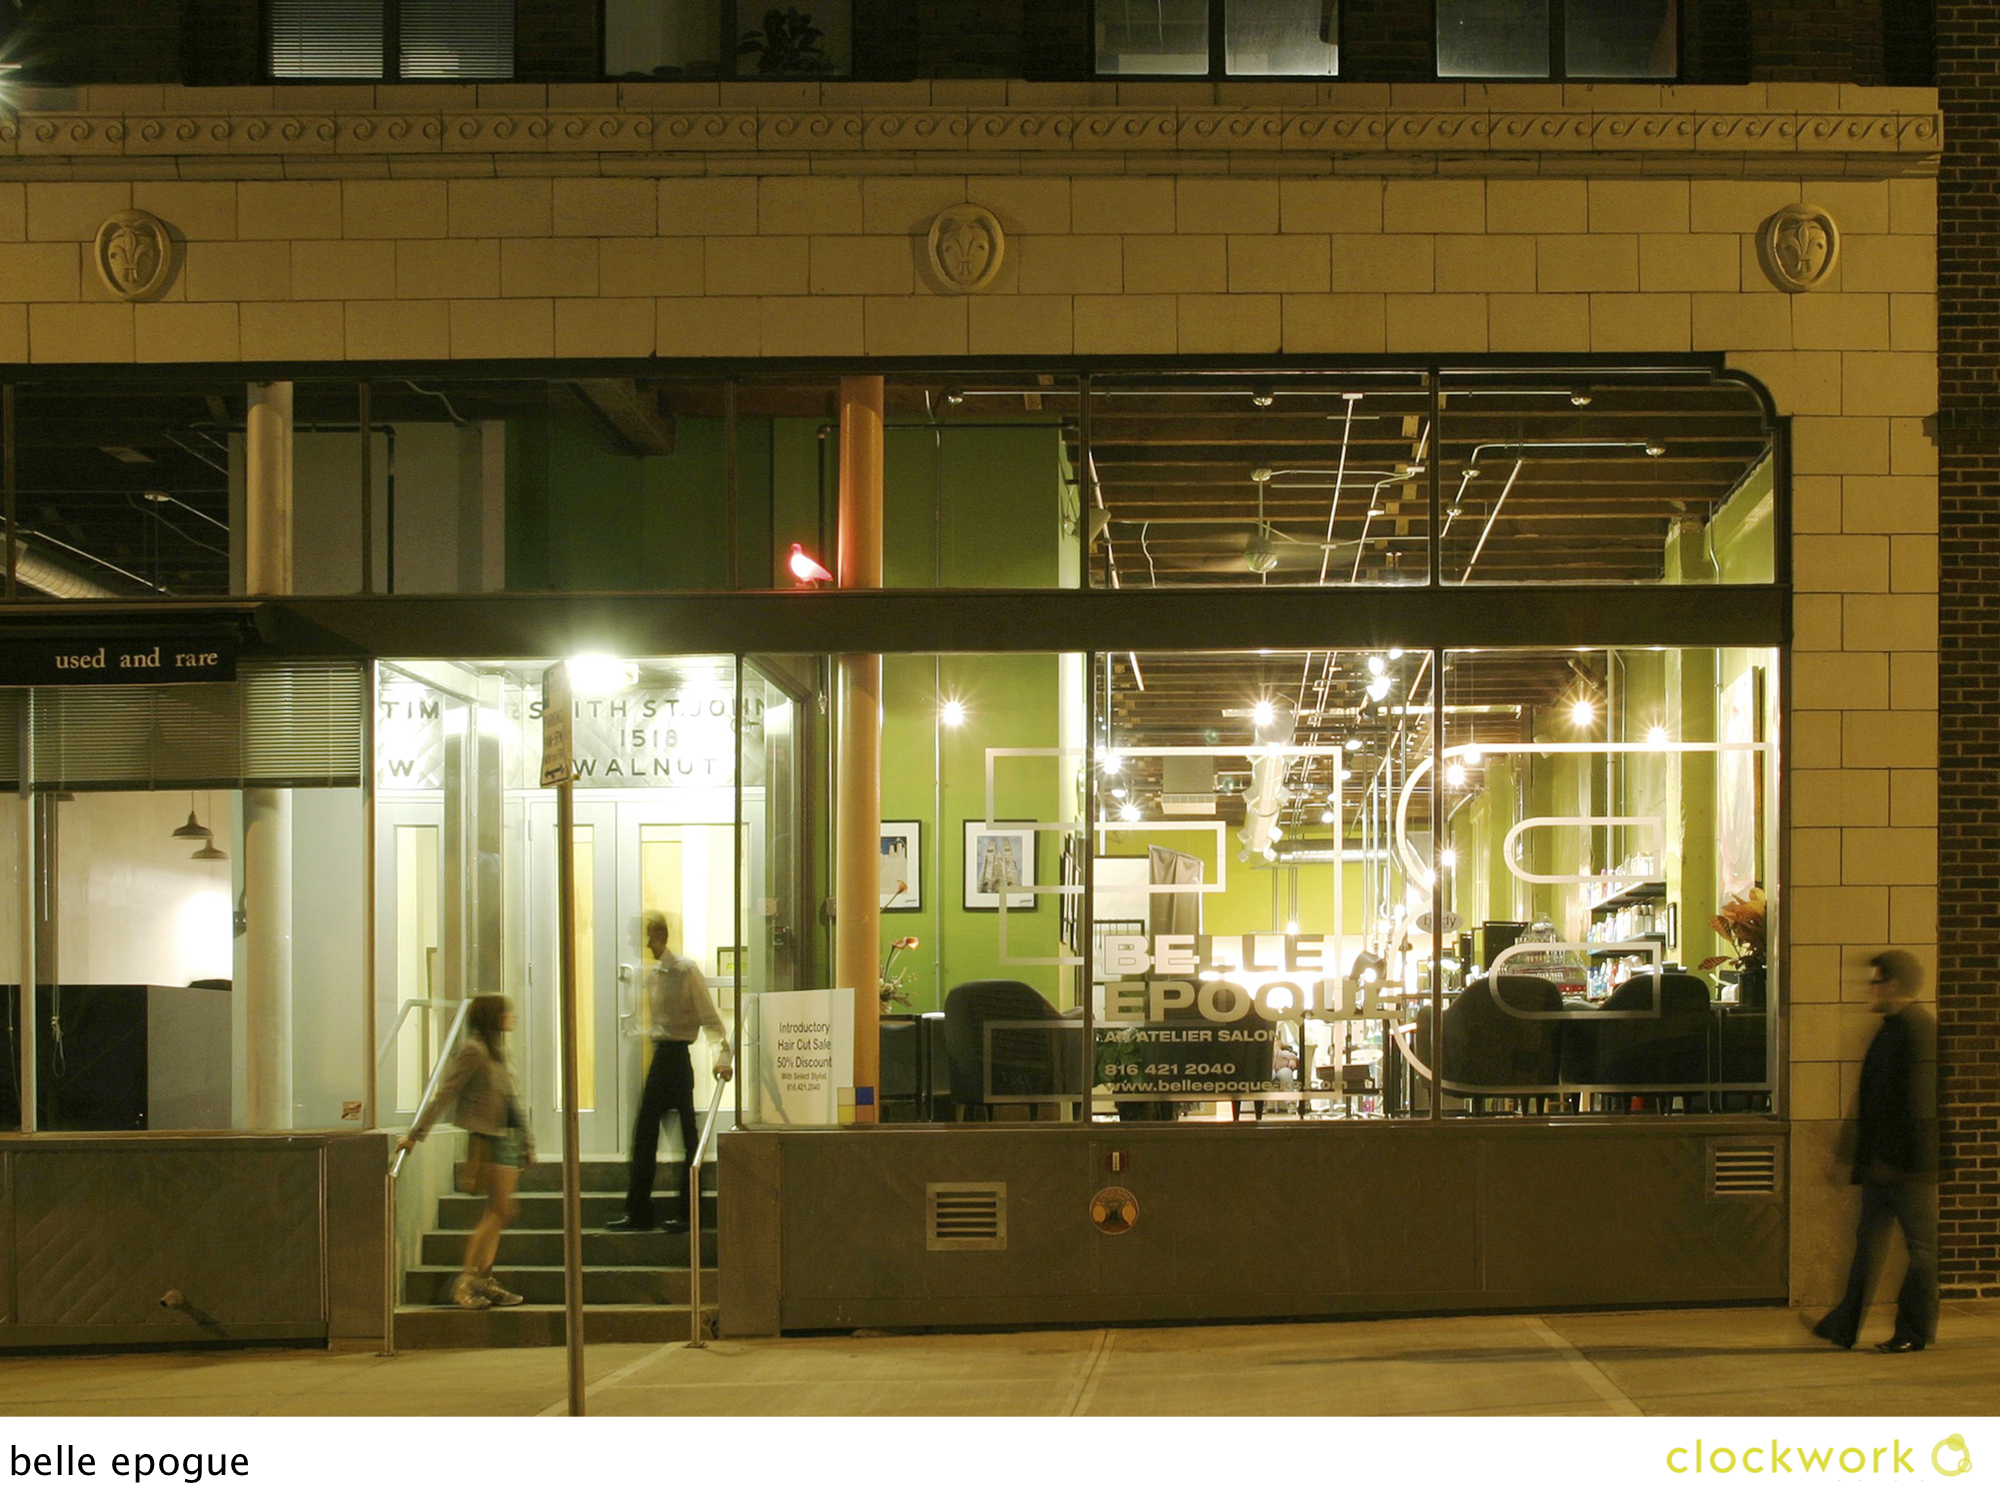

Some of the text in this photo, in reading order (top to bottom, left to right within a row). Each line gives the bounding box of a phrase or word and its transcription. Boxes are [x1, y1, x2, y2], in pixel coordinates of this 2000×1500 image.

[55, 647, 219, 669] used and rare
[528, 701, 627, 720] SITH
[620, 729, 679, 747] 1518
[572, 758, 717, 776] WALNUT
[1104, 934, 1325, 975] BELLE
[1104, 980, 1405, 1026] EPOQUE
[779, 1022, 831, 1035] Introductory
[1136, 1030, 1213, 1043] ATELIER
[1217, 1030, 1282, 1043] SALON
[777, 1038, 832, 1051] Hair Cut Sale
[776, 1056, 833, 1068] 50% Discount
[1104, 1063, 1237, 1076] 816 421 2040
